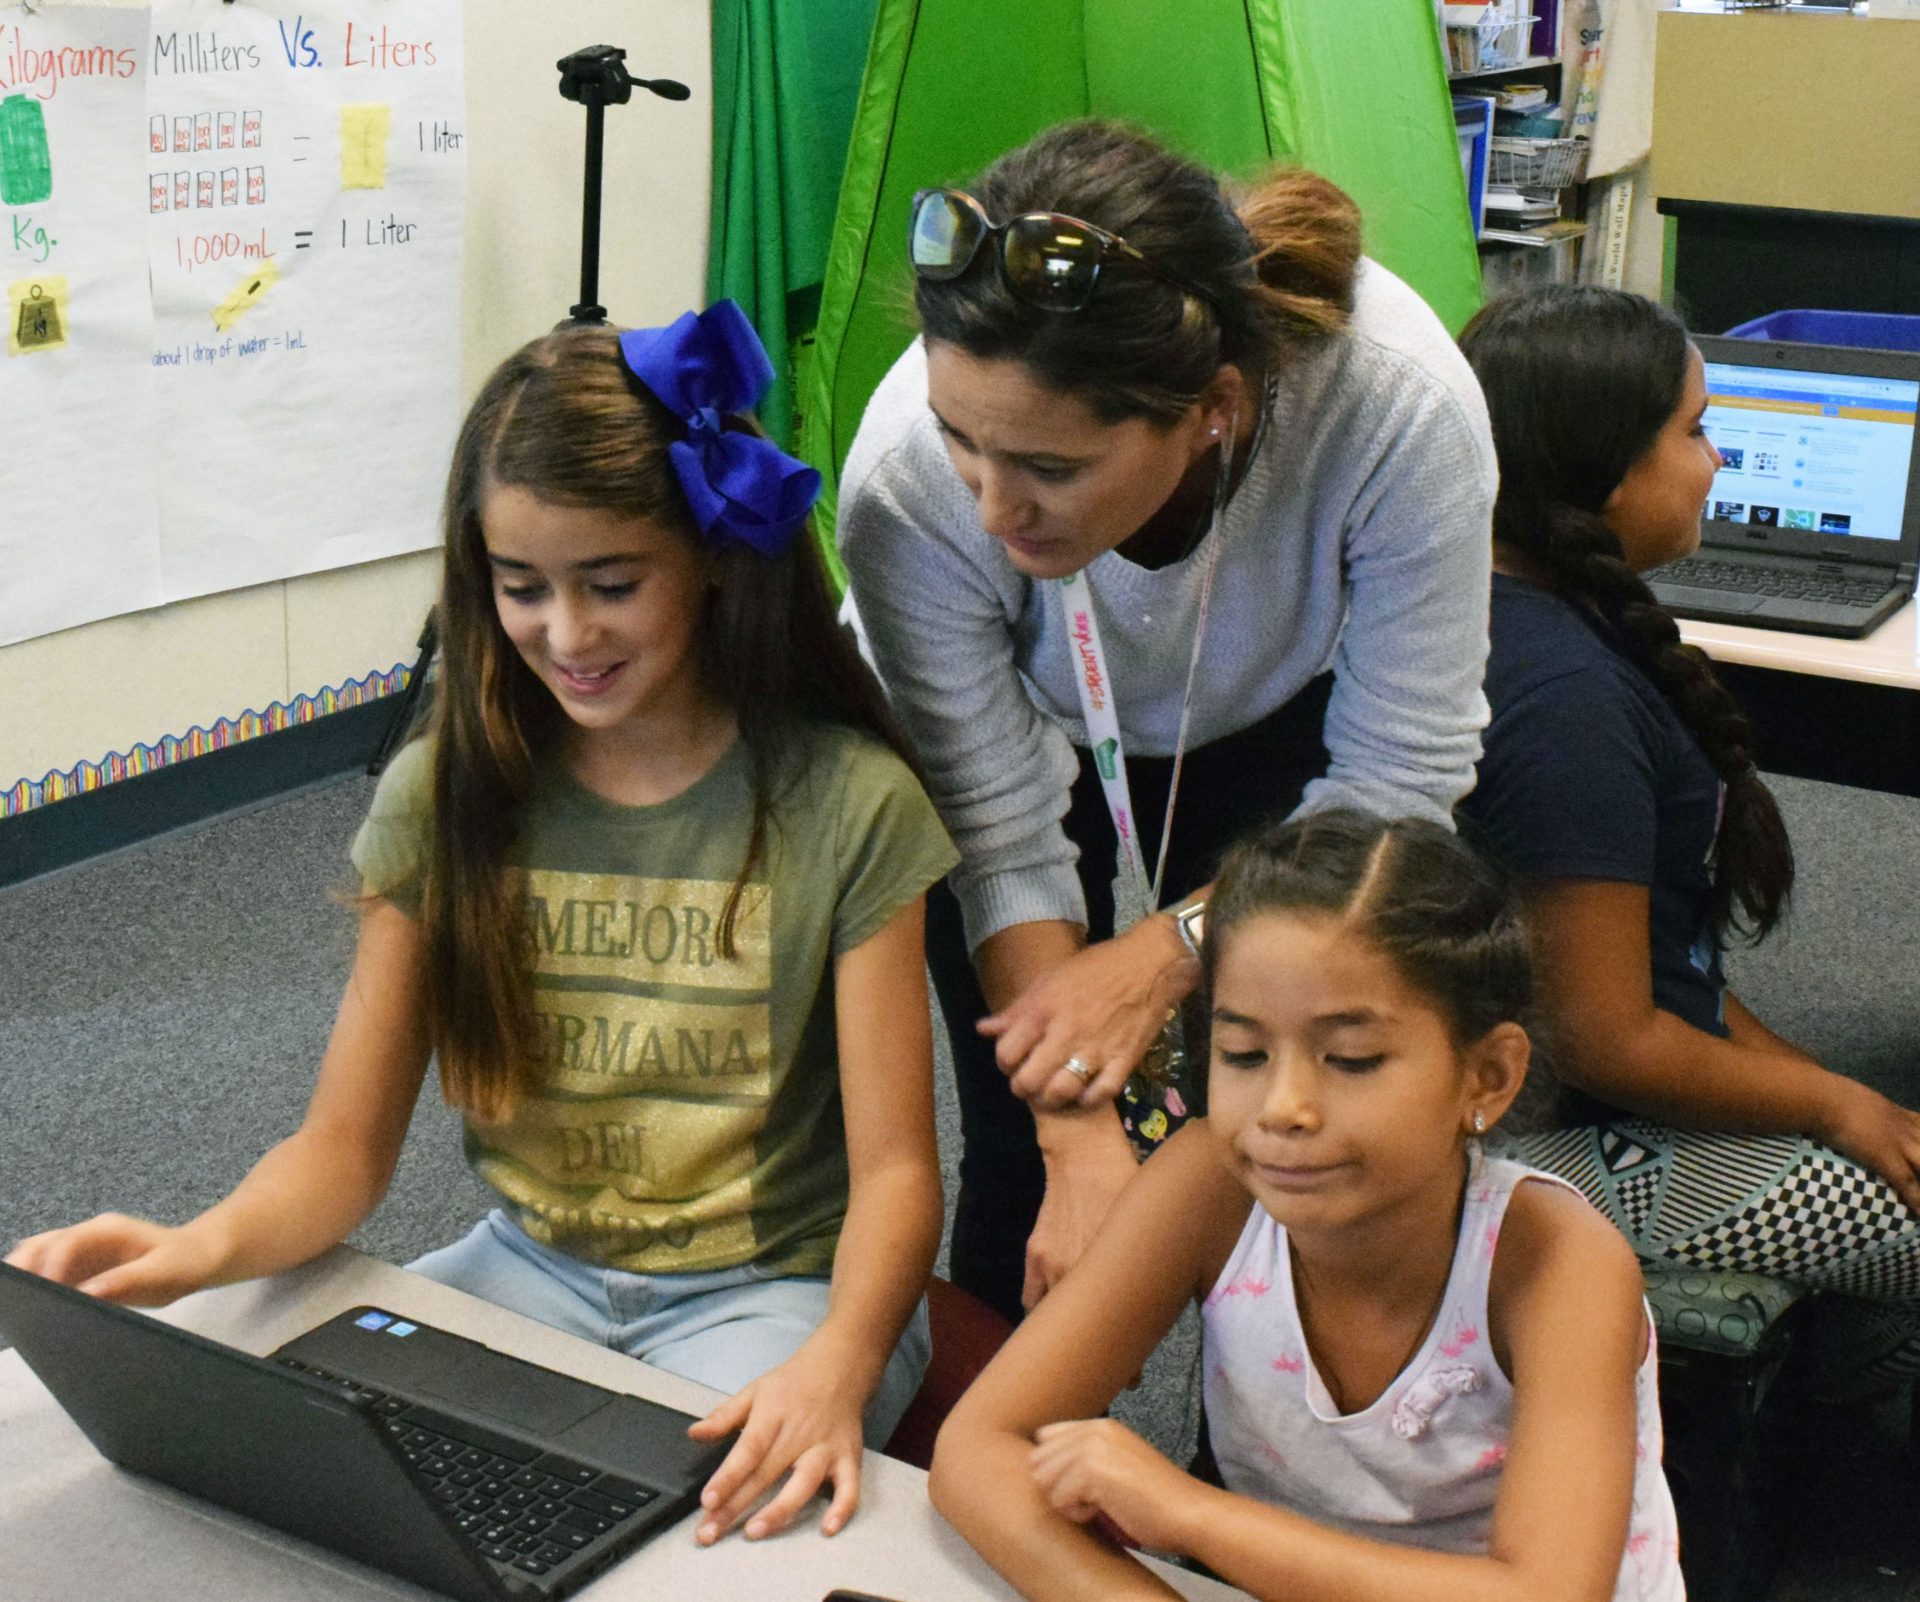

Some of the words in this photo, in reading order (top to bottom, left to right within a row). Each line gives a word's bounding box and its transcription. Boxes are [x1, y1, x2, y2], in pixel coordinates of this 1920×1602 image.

[0, 24, 136, 100] ilograms
[154, 32, 260, 75] Milliters
[279, 15, 322, 68] Vs.
[344, 22, 437, 70] Liters
[434, 121, 463, 153] liter
[366, 213, 417, 246] Liter
[152, 346, 181, 366] about
[193, 342, 217, 365] drop
[220, 338, 232, 357] of
[238, 336, 269, 357] water
[527, 895, 716, 967] MEJOR
